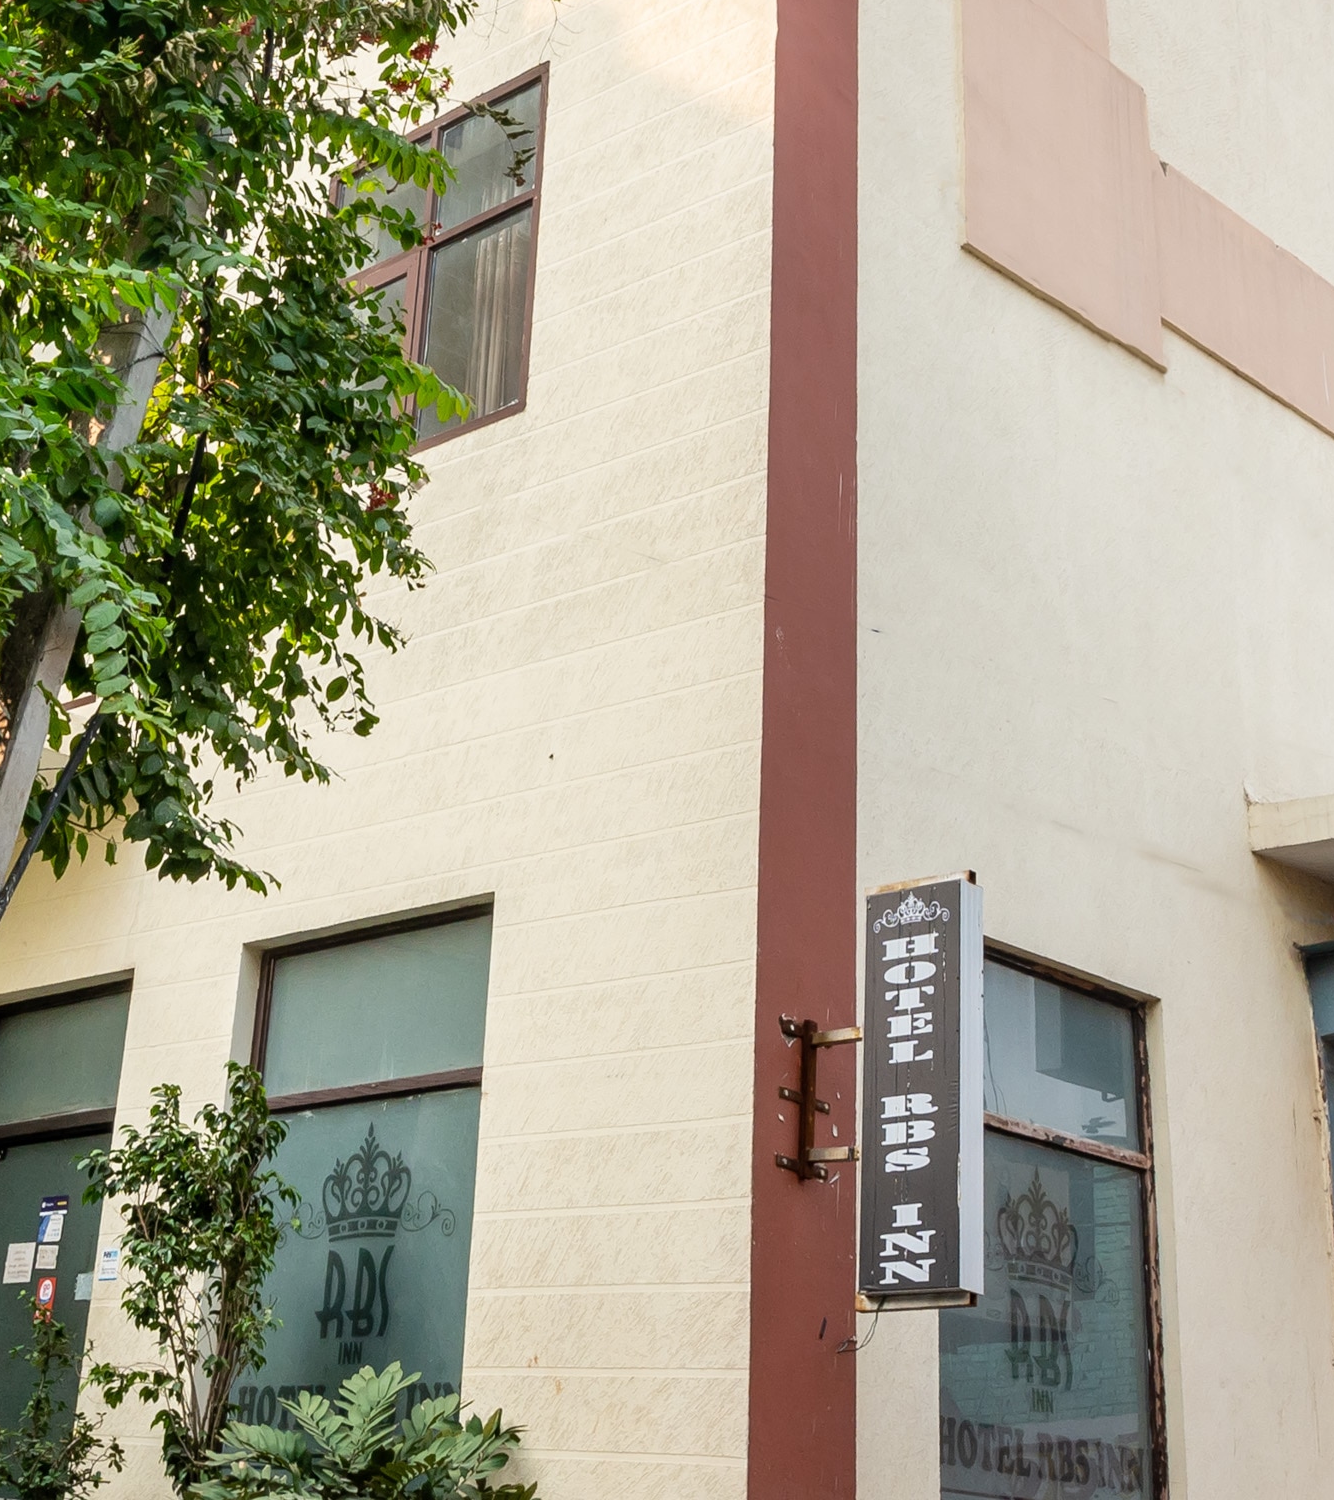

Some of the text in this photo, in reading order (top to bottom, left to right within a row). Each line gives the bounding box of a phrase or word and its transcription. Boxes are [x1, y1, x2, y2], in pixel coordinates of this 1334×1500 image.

[879, 932, 939, 1285] HOTEL RBS INN
[315, 1244, 395, 1340] RBS
[337, 1341, 364, 1365] INN
[1029, 1386, 1055, 1414] INN
[939, 1416, 1146, 1494] HOTEL RBS INN
